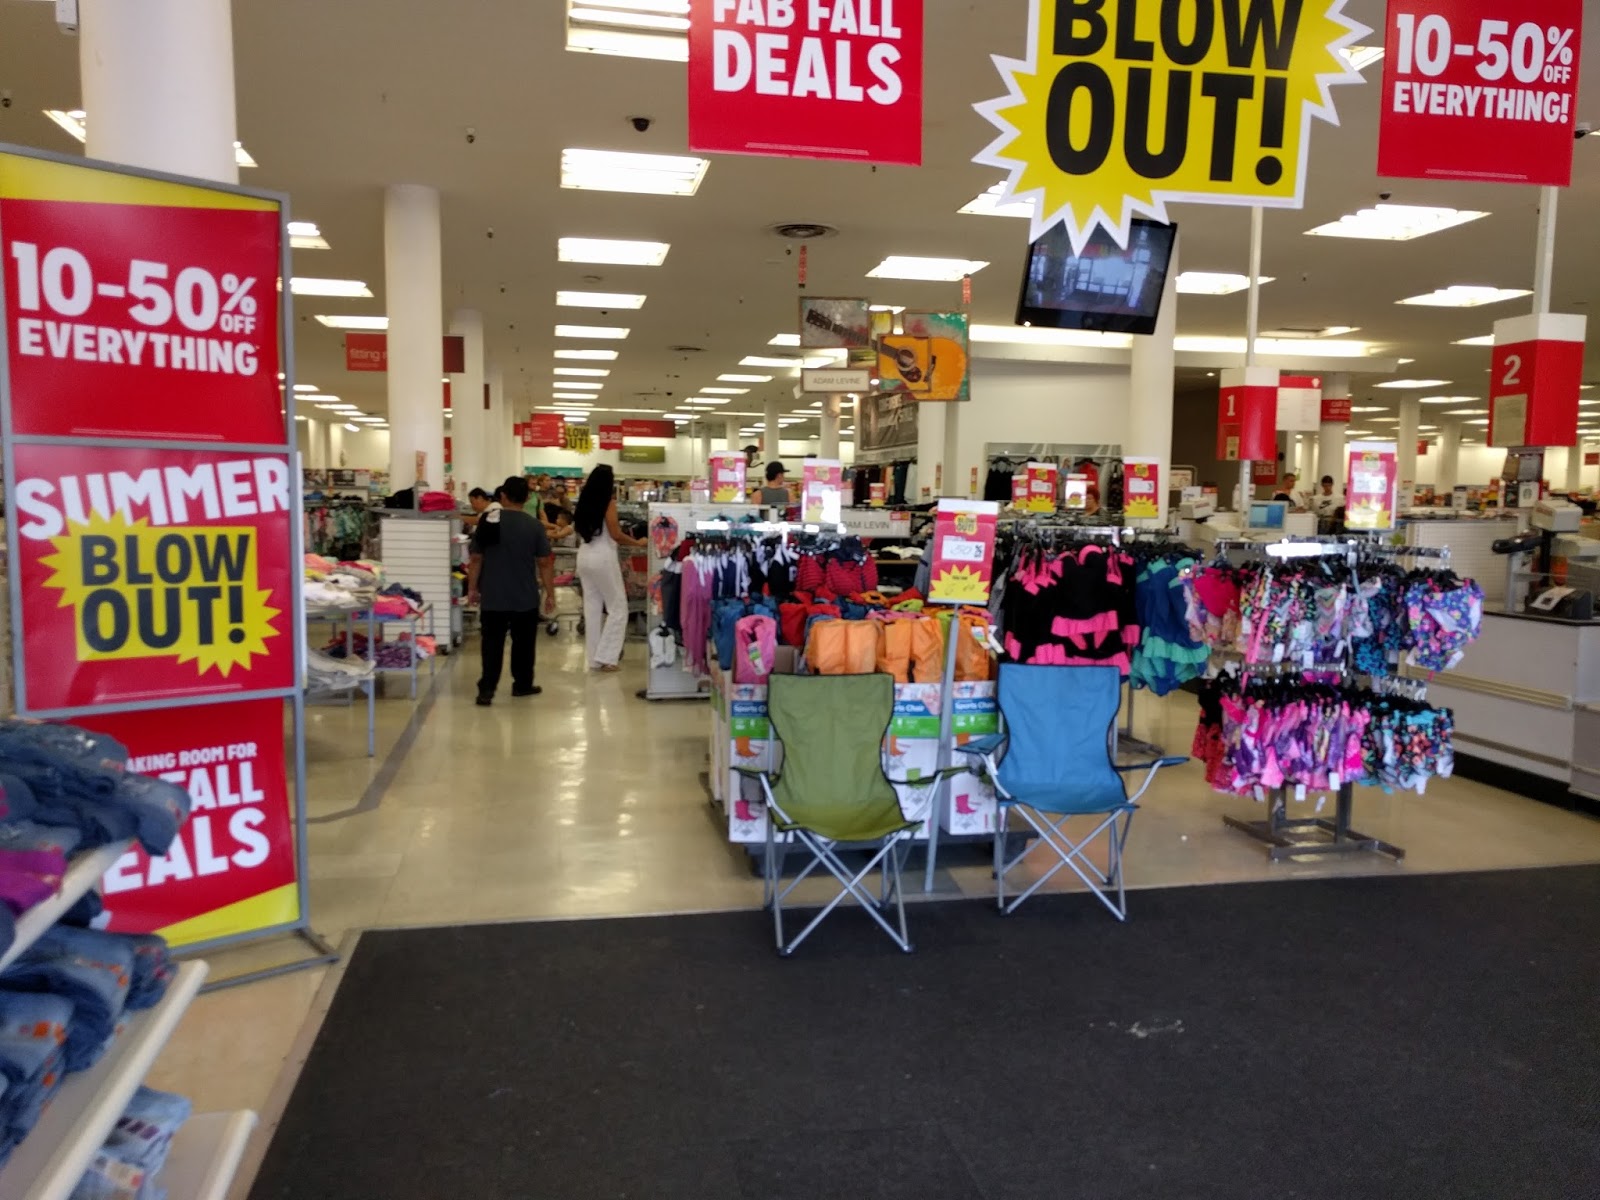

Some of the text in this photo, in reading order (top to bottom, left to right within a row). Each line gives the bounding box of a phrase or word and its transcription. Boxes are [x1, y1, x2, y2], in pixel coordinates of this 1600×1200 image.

[713, 0, 902, 39] FAB FALL
[1053, 0, 1303, 71] BLOW
[713, 29, 903, 106] DEALS
[1396, 13, 1575, 83] 10-50%
[1543, 64, 1572, 84] OFF
[1045, 61, 1289, 186] OUT!
[1393, 80, 1570, 124] EVERYTHING!
[11, 241, 257, 331] 10-50%
[18, 317, 258, 376] EVERYTHING
[220, 313, 255, 334] OFF
[1502, 354, 1522, 385] 2
[567, 428, 590, 437] LOW
[1226, 394, 1236, 416] 1
[15, 457, 290, 540] SUMMER
[80, 533, 250, 586] BLOW
[82, 585, 246, 653] OUT!
[125, 742, 257, 773] AKING ROOM FOR
[103, 807, 271, 894] EALS
